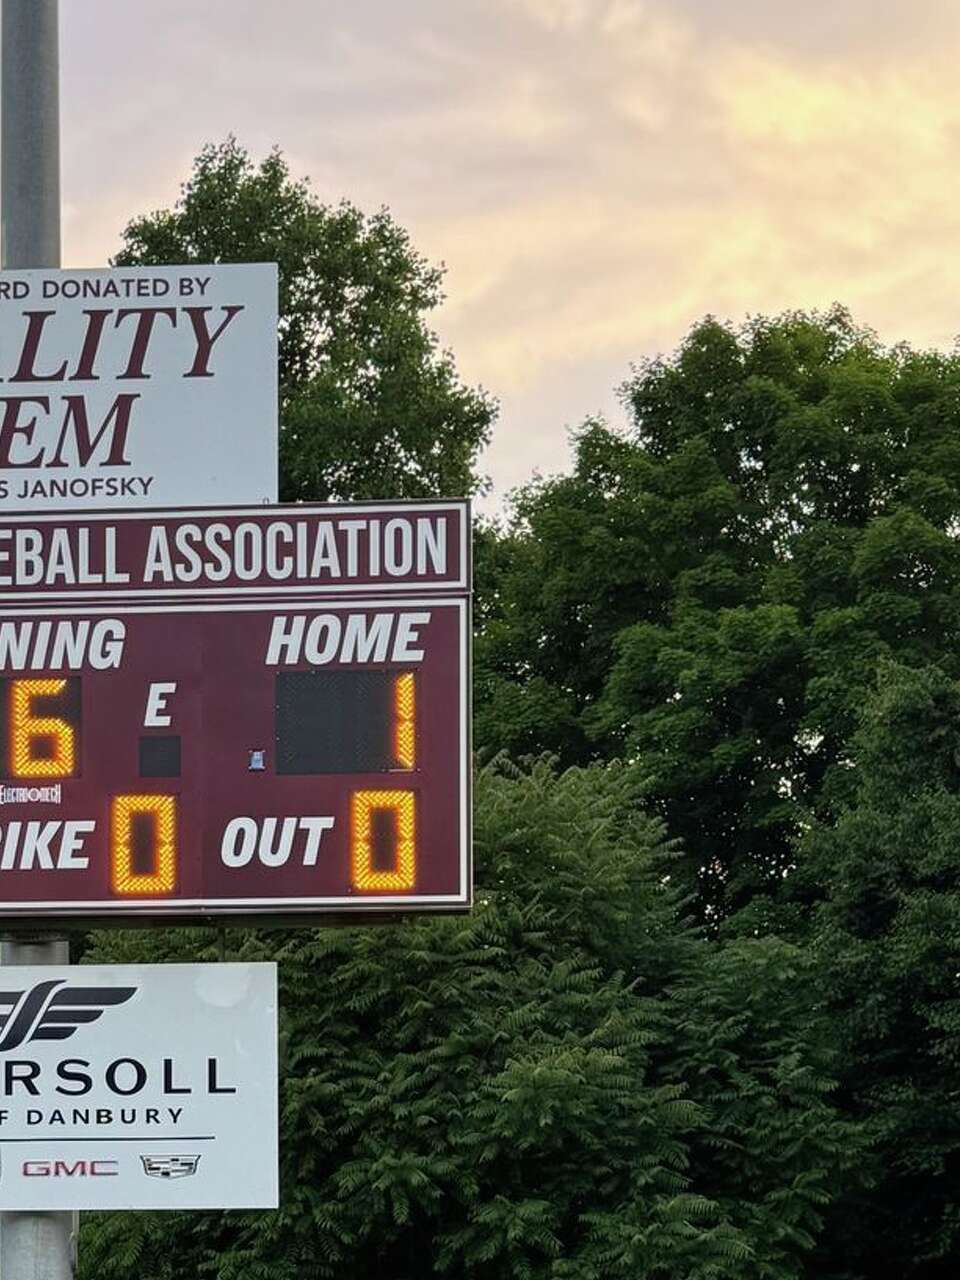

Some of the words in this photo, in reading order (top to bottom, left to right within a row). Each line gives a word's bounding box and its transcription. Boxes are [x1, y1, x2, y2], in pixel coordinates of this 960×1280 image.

[42, 278, 169, 299] DONATED
[179, 276, 211, 296] BY
[16, 476, 154, 499] JANOFSKY
[142, 516, 447, 583] ASSOCIATION
[265, 612, 431, 665] HOME
[10, 677, 75, 779] 6
[143, 682, 176, 727] E
[394, 671, 417, 770] 1
[112, 794, 176, 893] 0
[221, 816, 335, 868] OUT
[352, 790, 416, 891] 0
[26, 1107, 184, 1125] DANBURY
[22, 1160, 119, 1177] GMC
